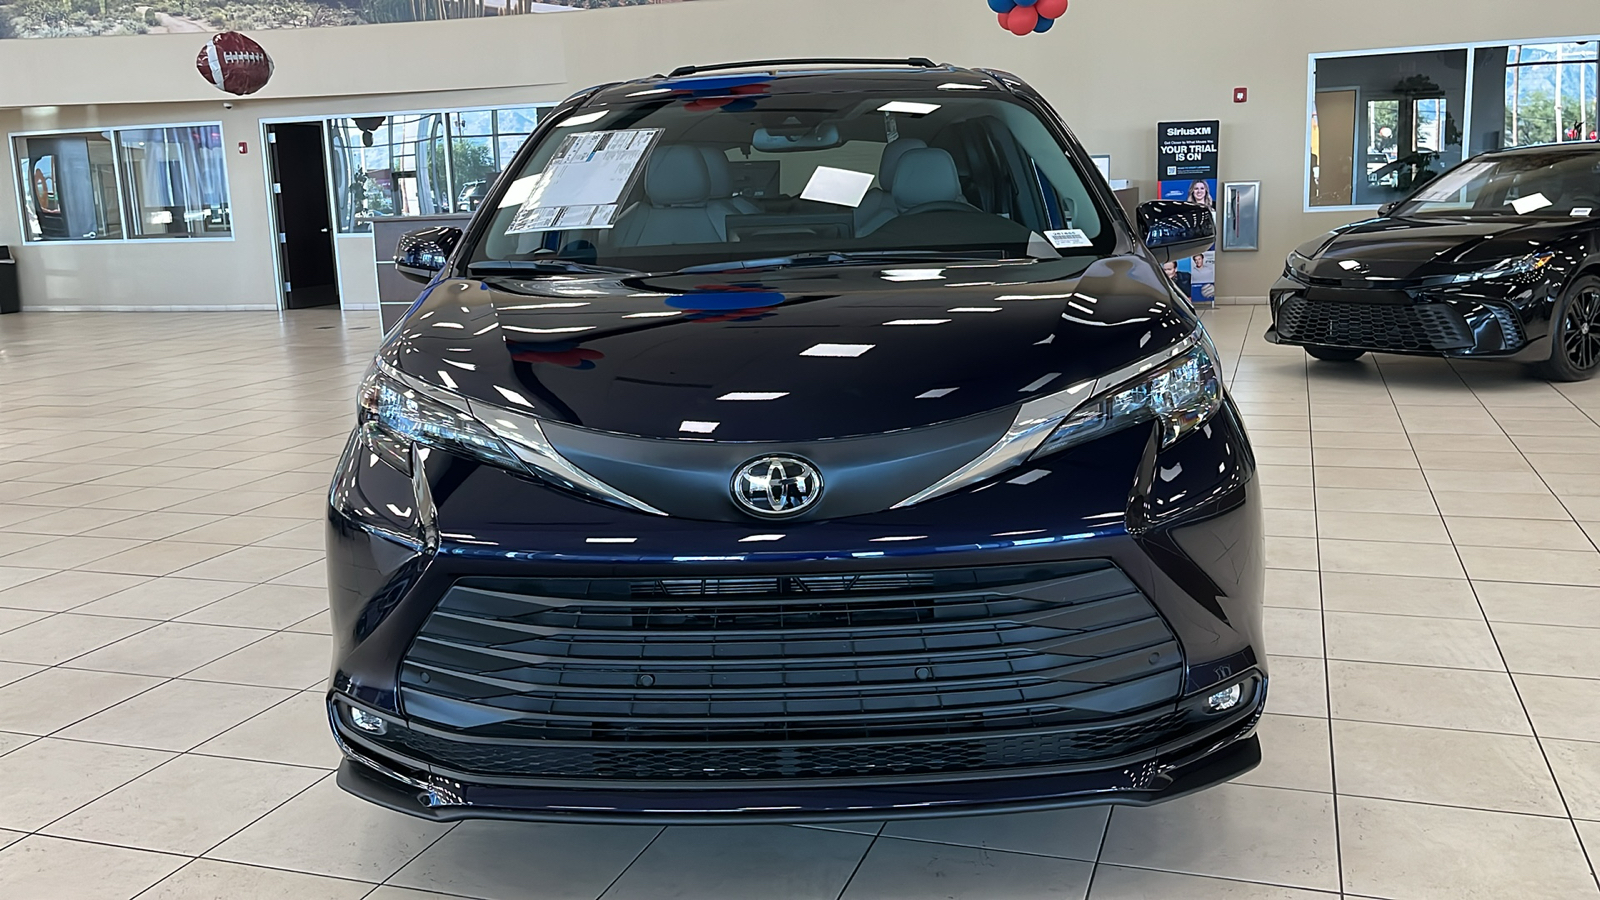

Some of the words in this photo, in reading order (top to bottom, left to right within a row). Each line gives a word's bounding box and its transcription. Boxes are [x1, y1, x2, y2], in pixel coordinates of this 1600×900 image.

[1167, 127, 1211, 136] SiriusXM
[1161, 146, 1187, 154] YOUR
[1189, 144, 1217, 152] TRIAL
